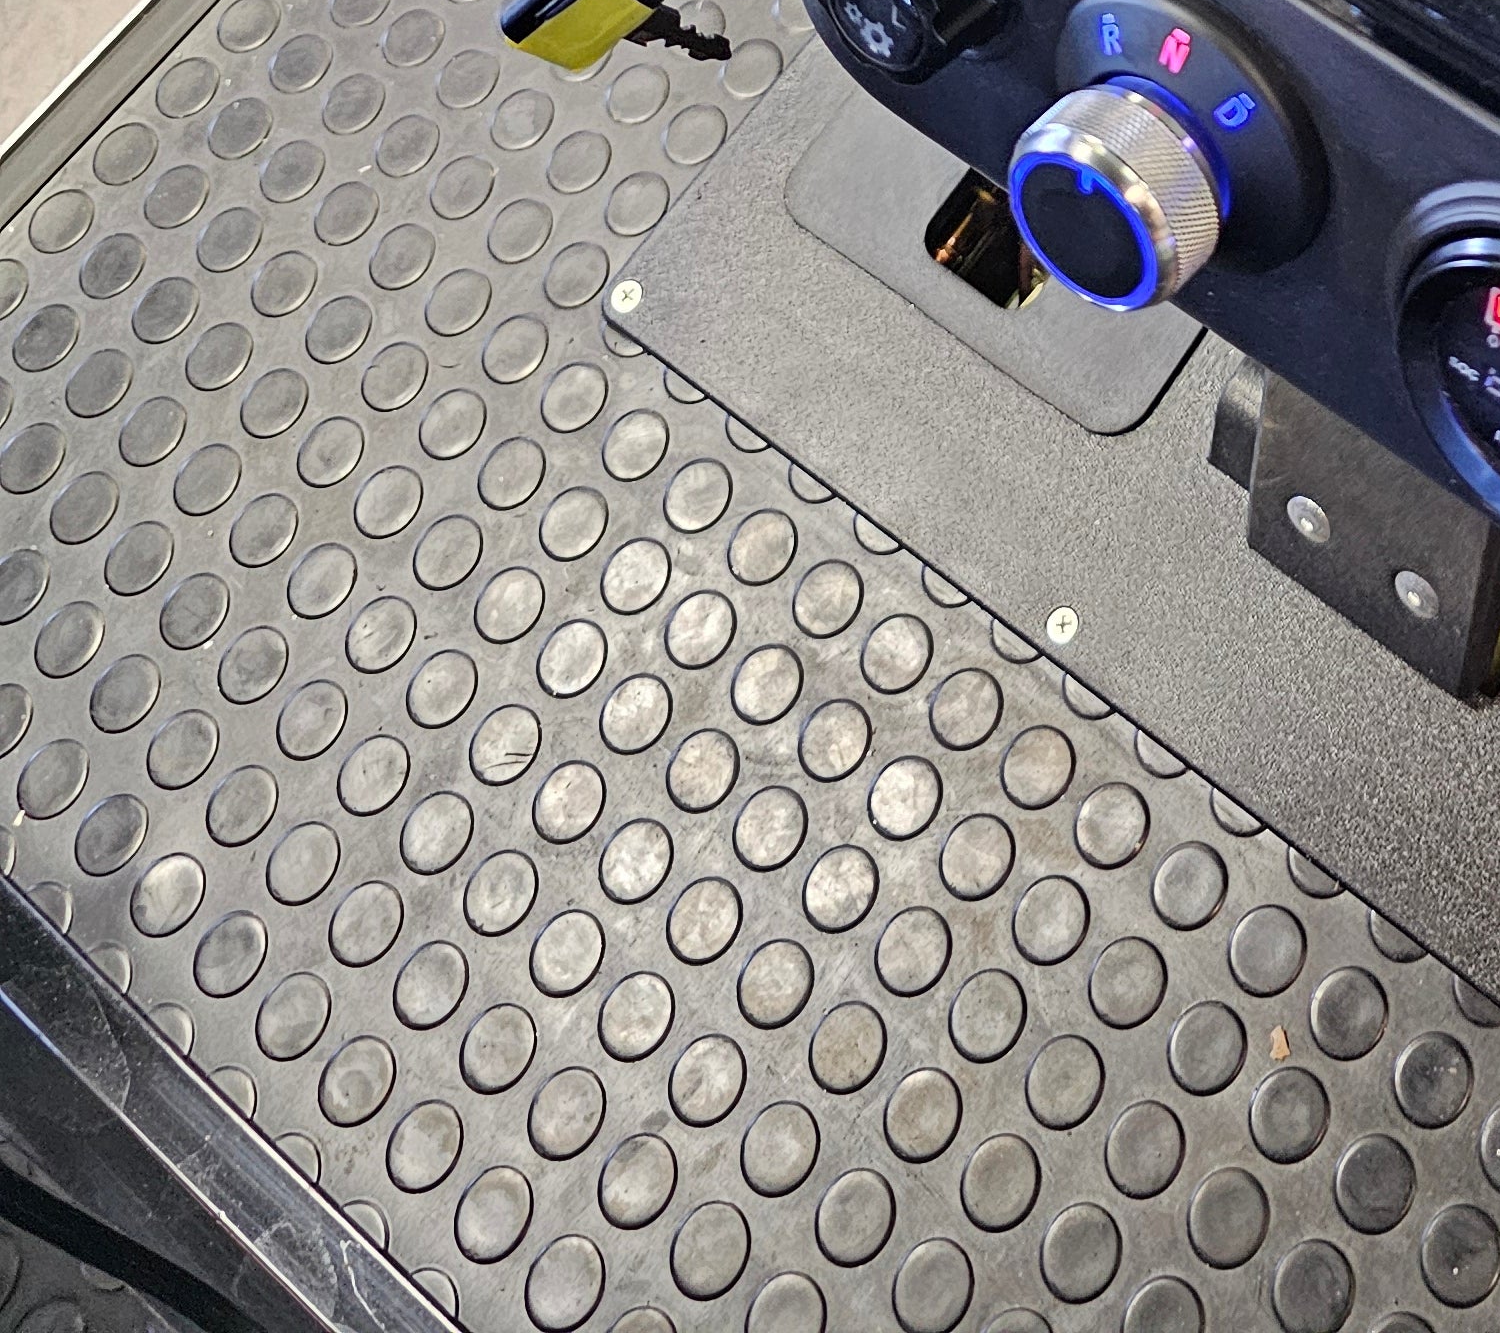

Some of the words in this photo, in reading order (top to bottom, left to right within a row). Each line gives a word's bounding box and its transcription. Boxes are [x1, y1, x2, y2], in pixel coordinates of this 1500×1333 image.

[1101, 23, 1123, 56] R
[1158, 33, 1191, 74] N
[1213, 95, 1250, 128] D
